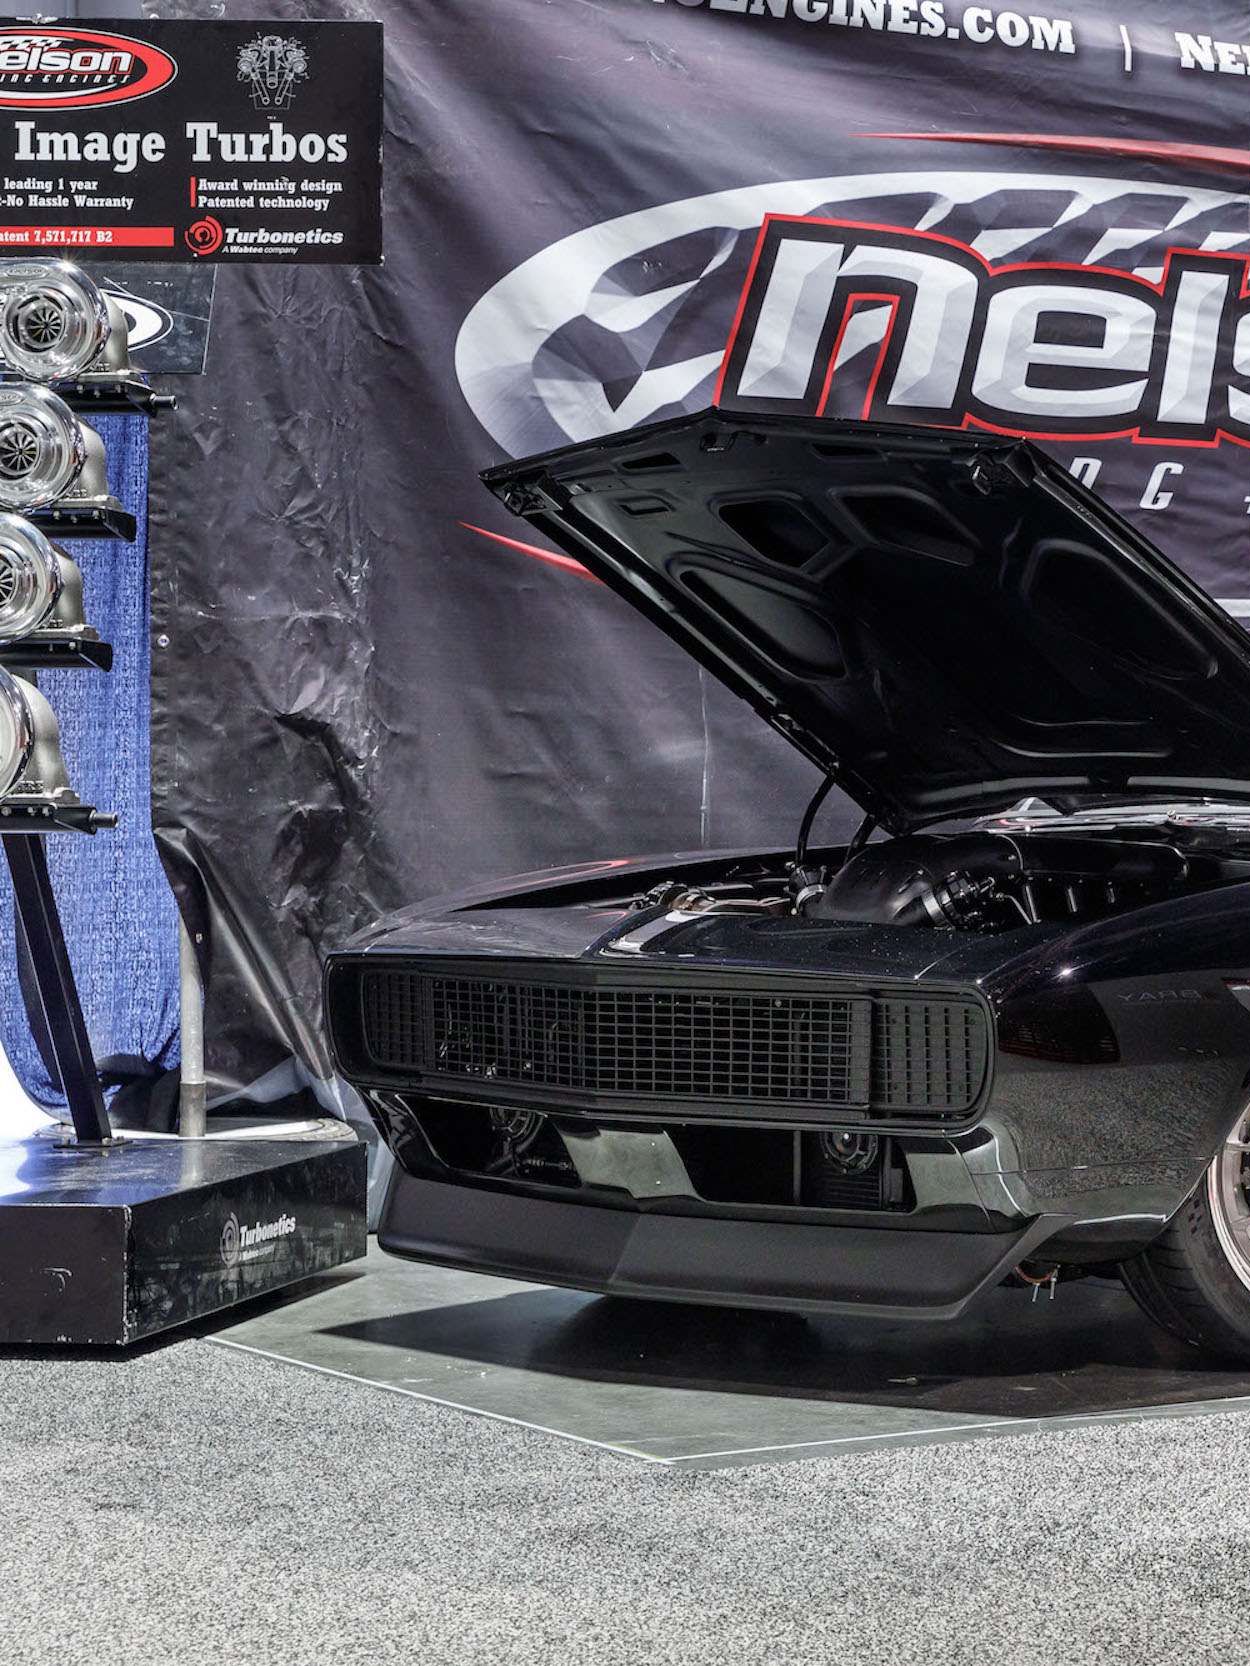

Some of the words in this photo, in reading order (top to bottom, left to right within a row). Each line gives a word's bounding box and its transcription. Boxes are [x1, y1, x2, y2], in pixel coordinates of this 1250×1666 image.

[652, 0, 1076, 54] NGINES.COM
[42, 74, 131, 84] ENGINES
[14, 121, 166, 173] Image
[185, 122, 348, 163] Turbos
[3, 177, 53, 192] leading
[57, 178, 65, 190] 1
[70, 180, 99, 193] year
[198, 178, 239, 191] Award
[242, 178, 297, 194] winning
[300, 179, 344, 194] design
[0, 195, 24, 207] -No
[28, 195, 70, 207] Hassle
[73, 195, 135, 210] Warranty
[198, 196, 255, 209] Patented
[259, 196, 330, 211] technology
[33, 230, 92, 244] 7,571,717
[96, 231, 113, 242] B2
[225, 227, 344, 244] Turbonetics
[240, 1213, 297, 1248] Turbonetics
